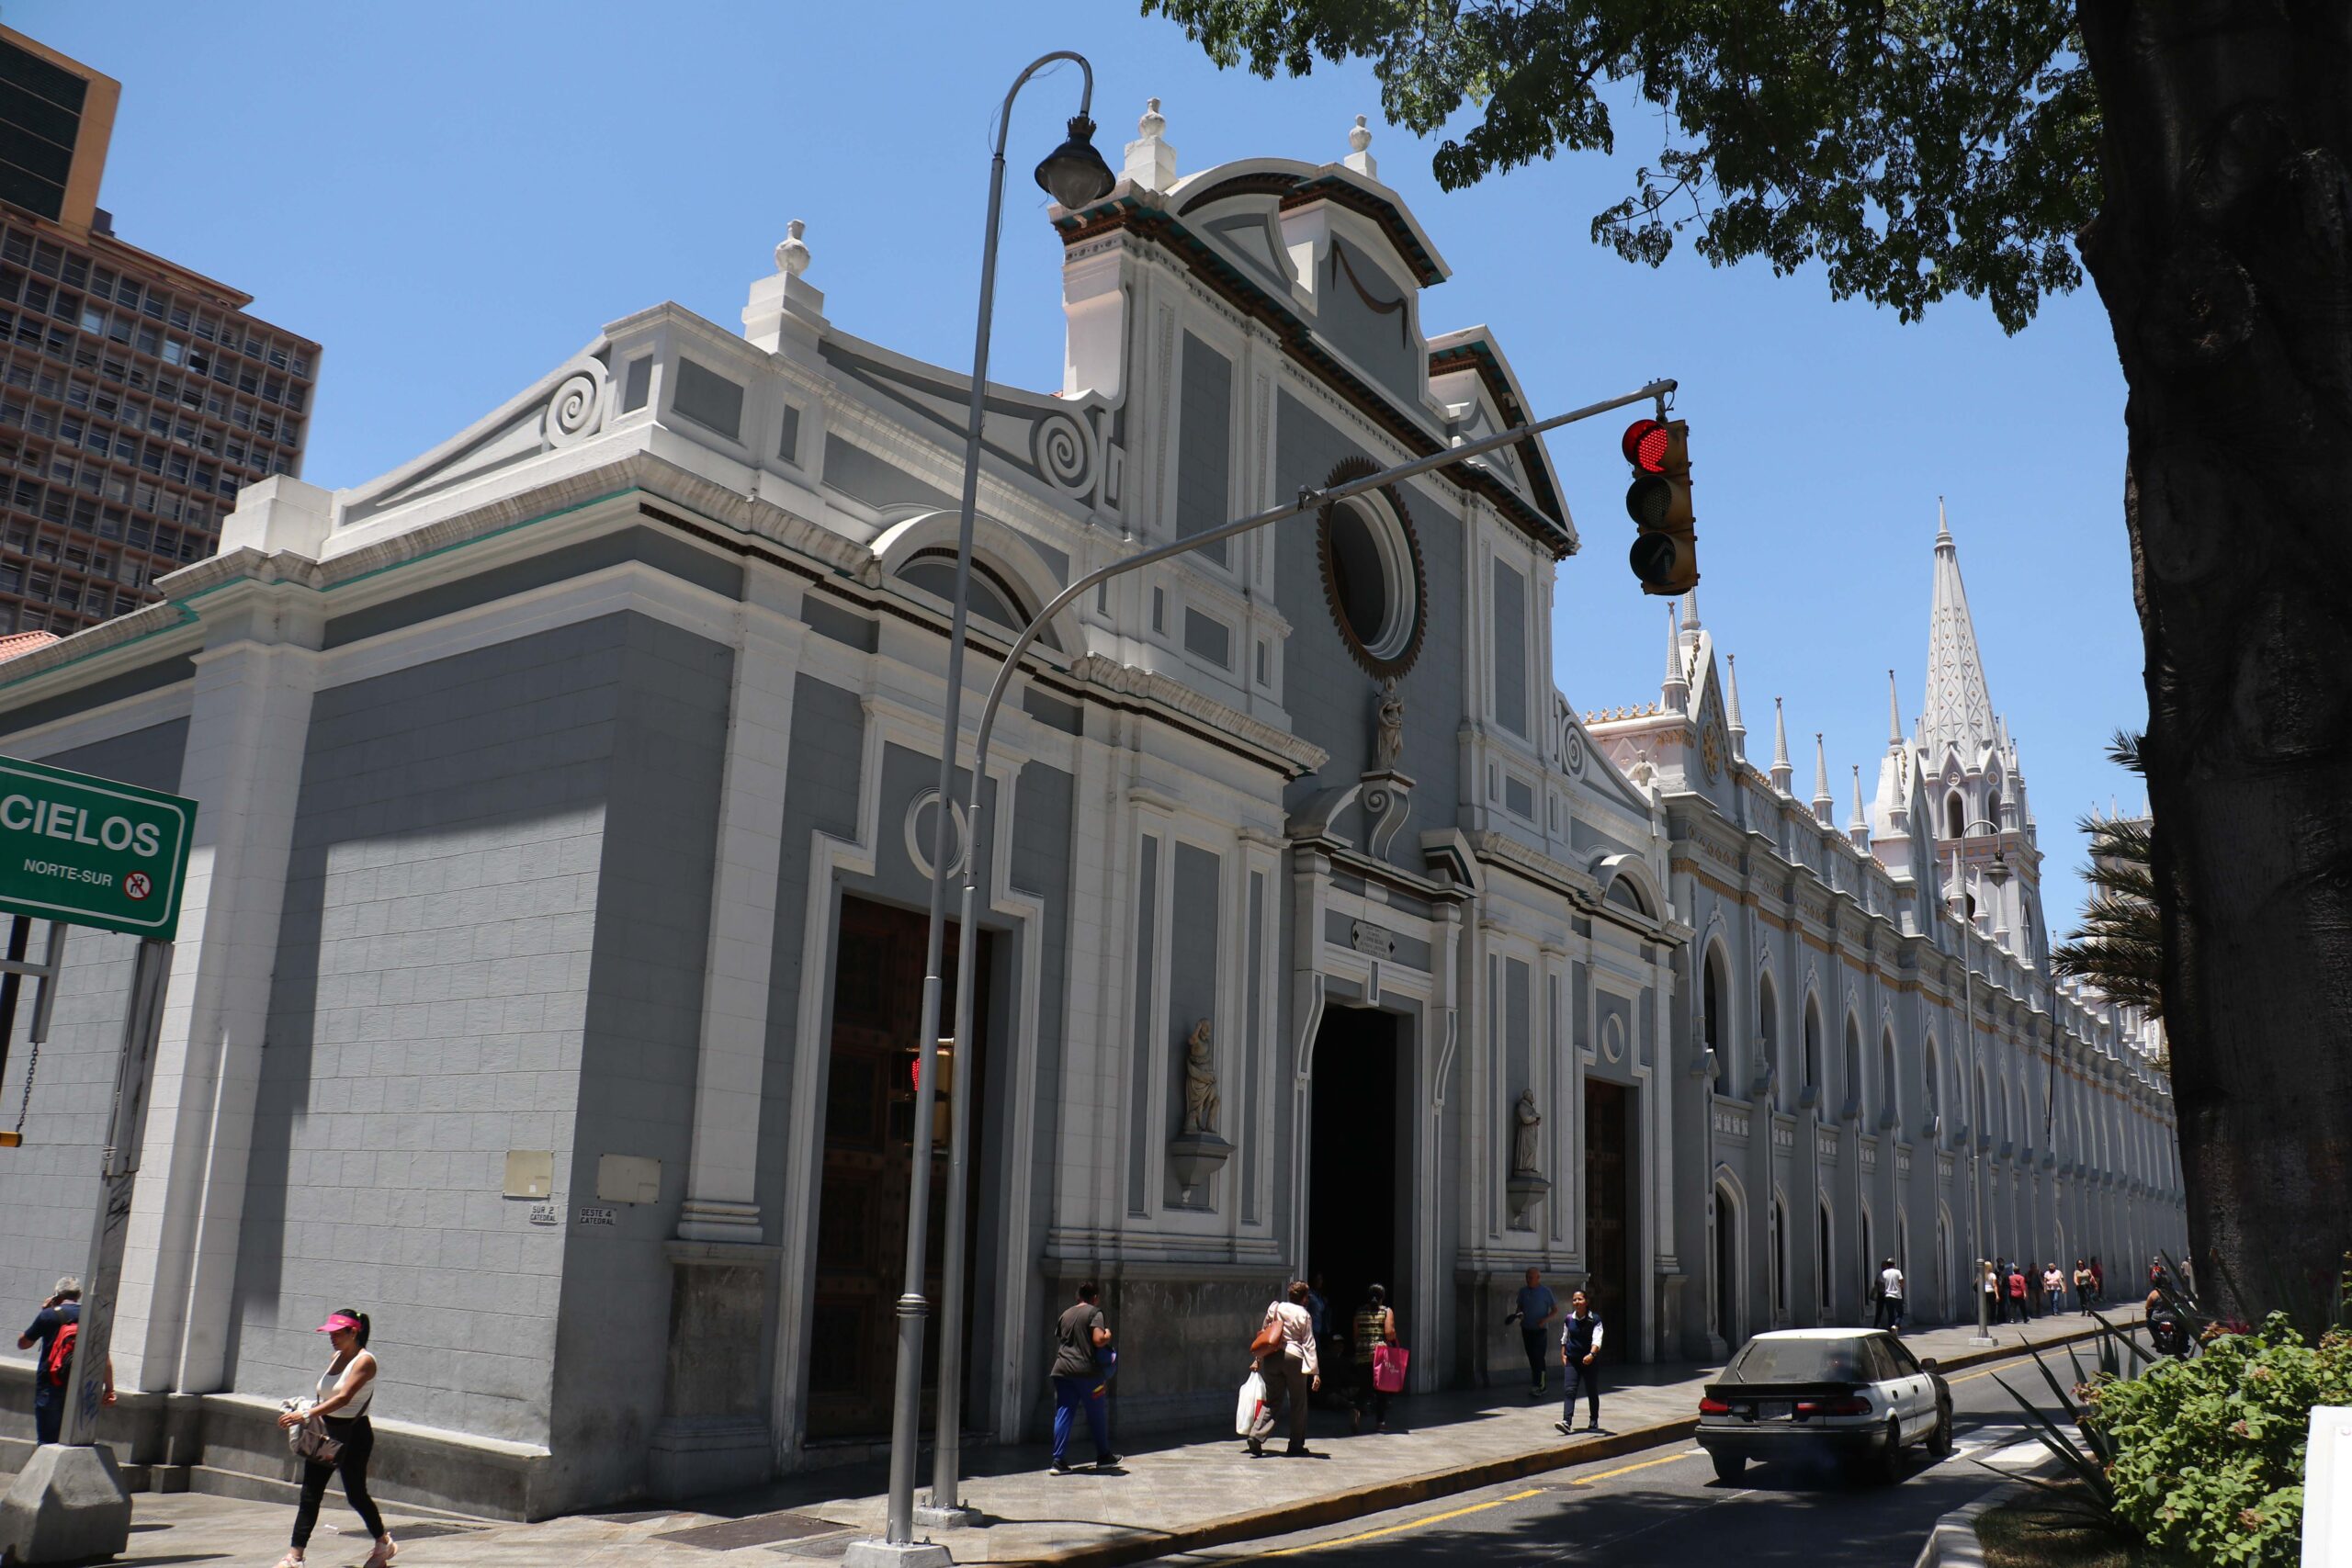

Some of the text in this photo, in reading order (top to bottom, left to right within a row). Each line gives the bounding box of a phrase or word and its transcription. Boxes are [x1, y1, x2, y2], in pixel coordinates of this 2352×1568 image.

[0, 794, 161, 857] CIELOS
[24, 858, 113, 886] NORTE-SUR
[532, 1206, 555, 1214] SUR 2
[581, 1209, 603, 1217] OESTE
[581, 1217, 614, 1225] CATEDRAL
